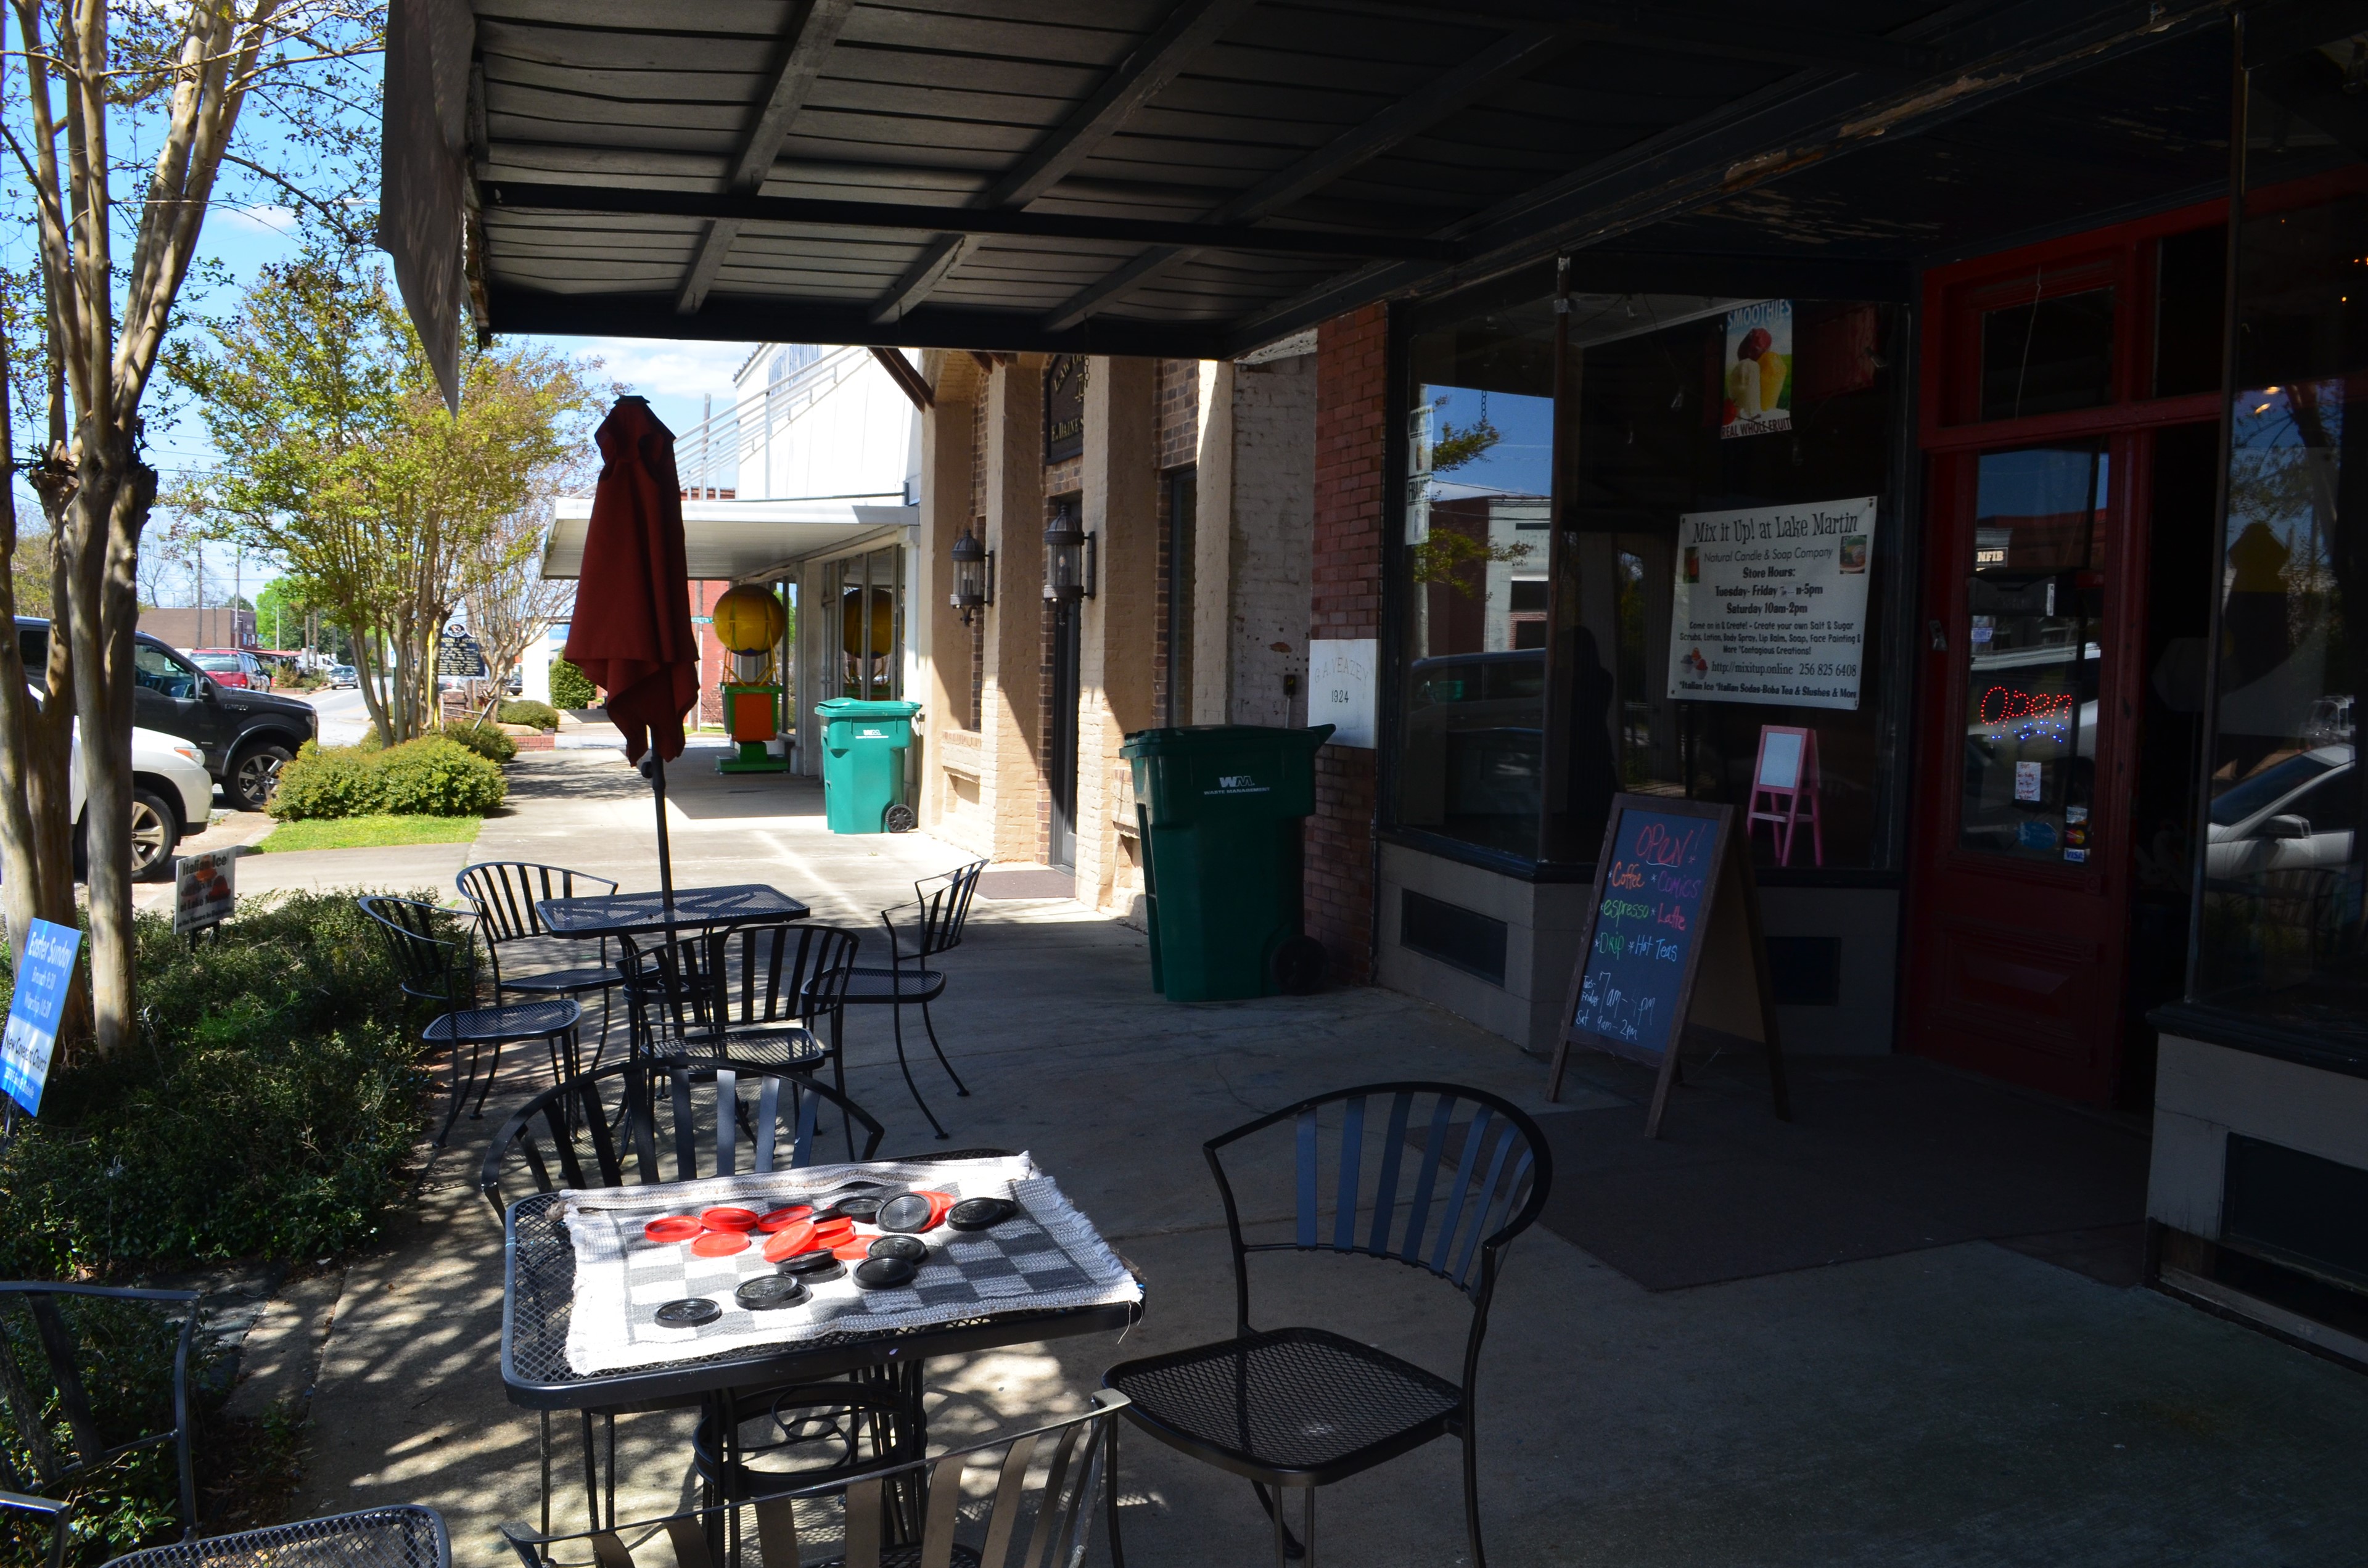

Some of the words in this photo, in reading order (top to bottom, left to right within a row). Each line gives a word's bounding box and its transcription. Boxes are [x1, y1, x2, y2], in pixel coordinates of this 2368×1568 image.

[1727, 298, 1793, 330] SMOOTHIES
[1721, 425, 1738, 438] REAL
[1740, 421, 1766, 435] WHOLE
[1769, 418, 1790, 432] FRUIT
[1693, 522, 1717, 543] Mix
[1720, 522, 1730, 541] it
[1733, 518, 1755, 544] Up!
[1759, 521, 1772, 539] at
[1775, 515, 1807, 538] Lake
[1812, 512, 1857, 536] Martin
[1704, 551, 1732, 562] Natural
[1735, 549, 1762, 561] Candle
[1764, 549, 1770, 560] &
[1772, 548, 1792, 562] Soap
[1794, 547, 1833, 560] Company
[1743, 567, 1766, 578] Store
[1767, 566, 1796, 577] Hours:
[1752, 585, 1778, 598] Friday
[1727, 602, 1762, 616] Saturday
[1765, 602, 1807, 617] 10am-2pm
[1811, 621, 1825, 629] Salt
[1834, 621, 1854, 631] Sugar
[1724, 633, 1737, 642] Body
[1738, 634, 1758, 642] Spray,
[1759, 634, 1768, 643] Lip
[1789, 634, 1808, 644] Soap,
[1828, 634, 1855, 644] Painting
[1723, 645, 1737, 653] More
[1777, 646, 1811, 654] Creations!
[1331, 657, 1370, 687] VEAZEY
[1711, 661, 1793, 676] http://mixitup.online
[1799, 663, 1815, 675] 256
[1817, 663, 1833, 676] 825
[1836, 664, 1857, 676] 6408
[1332, 689, 1349, 704] 1924
[1704, 681, 1714, 690] Ice
[1782, 685, 1793, 694] Tea
[1794, 686, 1800, 695] &
[1802, 686, 1830, 697] Slushes
[1832, 688, 1838, 697] &
[1840, 688, 1857, 698] More
[1981, 686, 2073, 732] Open
[2066, 850, 2083, 860] VISA
[183, 859, 210, 876] Italian
[213, 854, 228, 868] Ice
[28, 931, 50, 960] Easter
[47, 937, 73, 977] Sunday
[1656, 938, 1678, 962] Teas
[4, 1031, 16, 1052] New
[33, 1048, 48, 1072] Church
